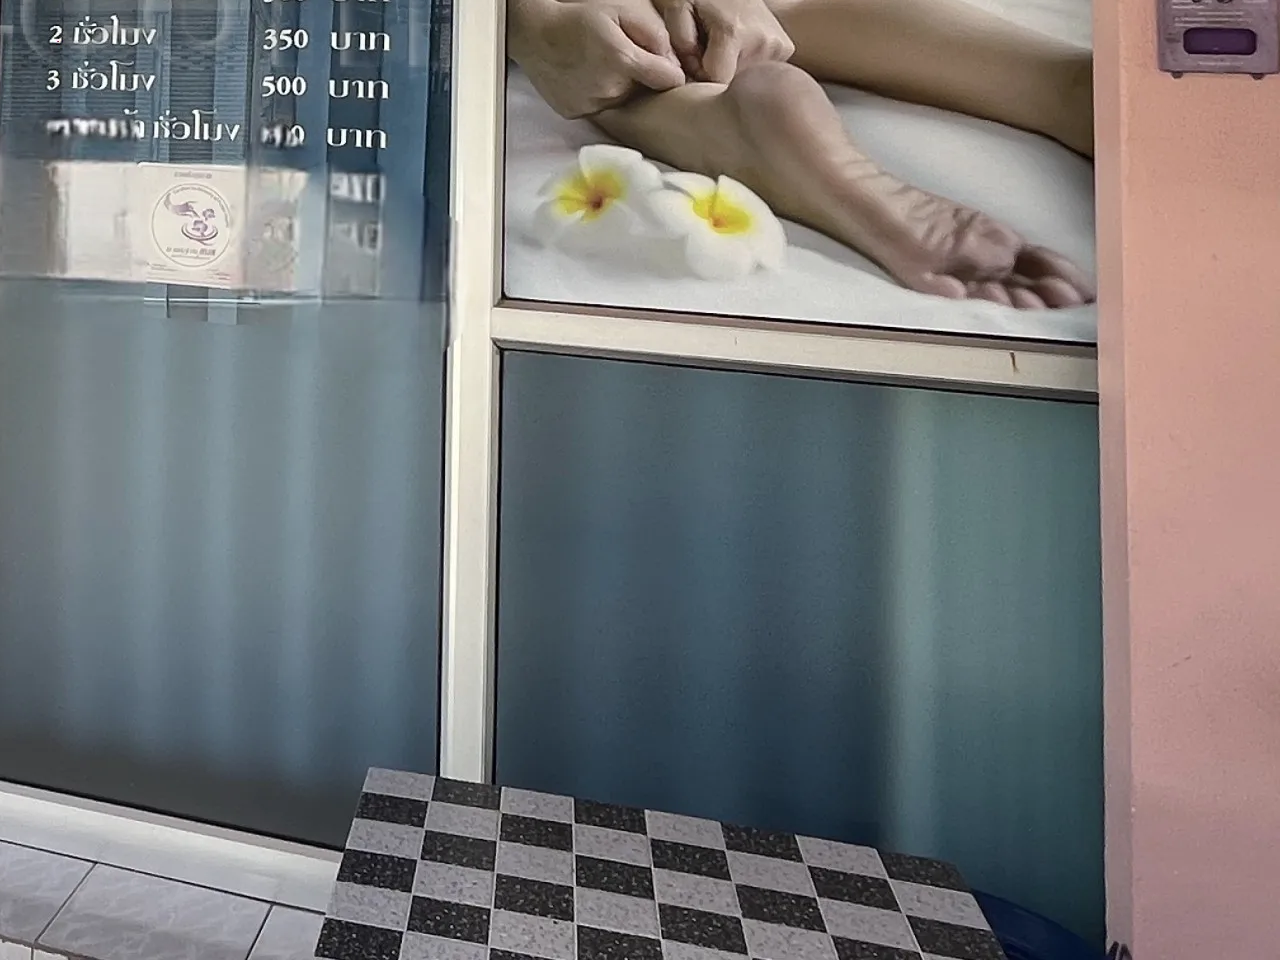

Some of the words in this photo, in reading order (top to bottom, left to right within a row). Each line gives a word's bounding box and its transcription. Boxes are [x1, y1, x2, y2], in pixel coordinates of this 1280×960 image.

[49, 25, 63, 44] 2
[73, 14, 157, 46] ชั่วโมง
[263, 29, 309, 51] 350
[331, 31, 391, 51] บาท
[46, 70, 61, 91] 3
[72, 60, 156, 92] ชั่วโมง
[261, 75, 307, 98] 500
[329, 78, 389, 100] บาท
[326, 127, 387, 149] บาท
